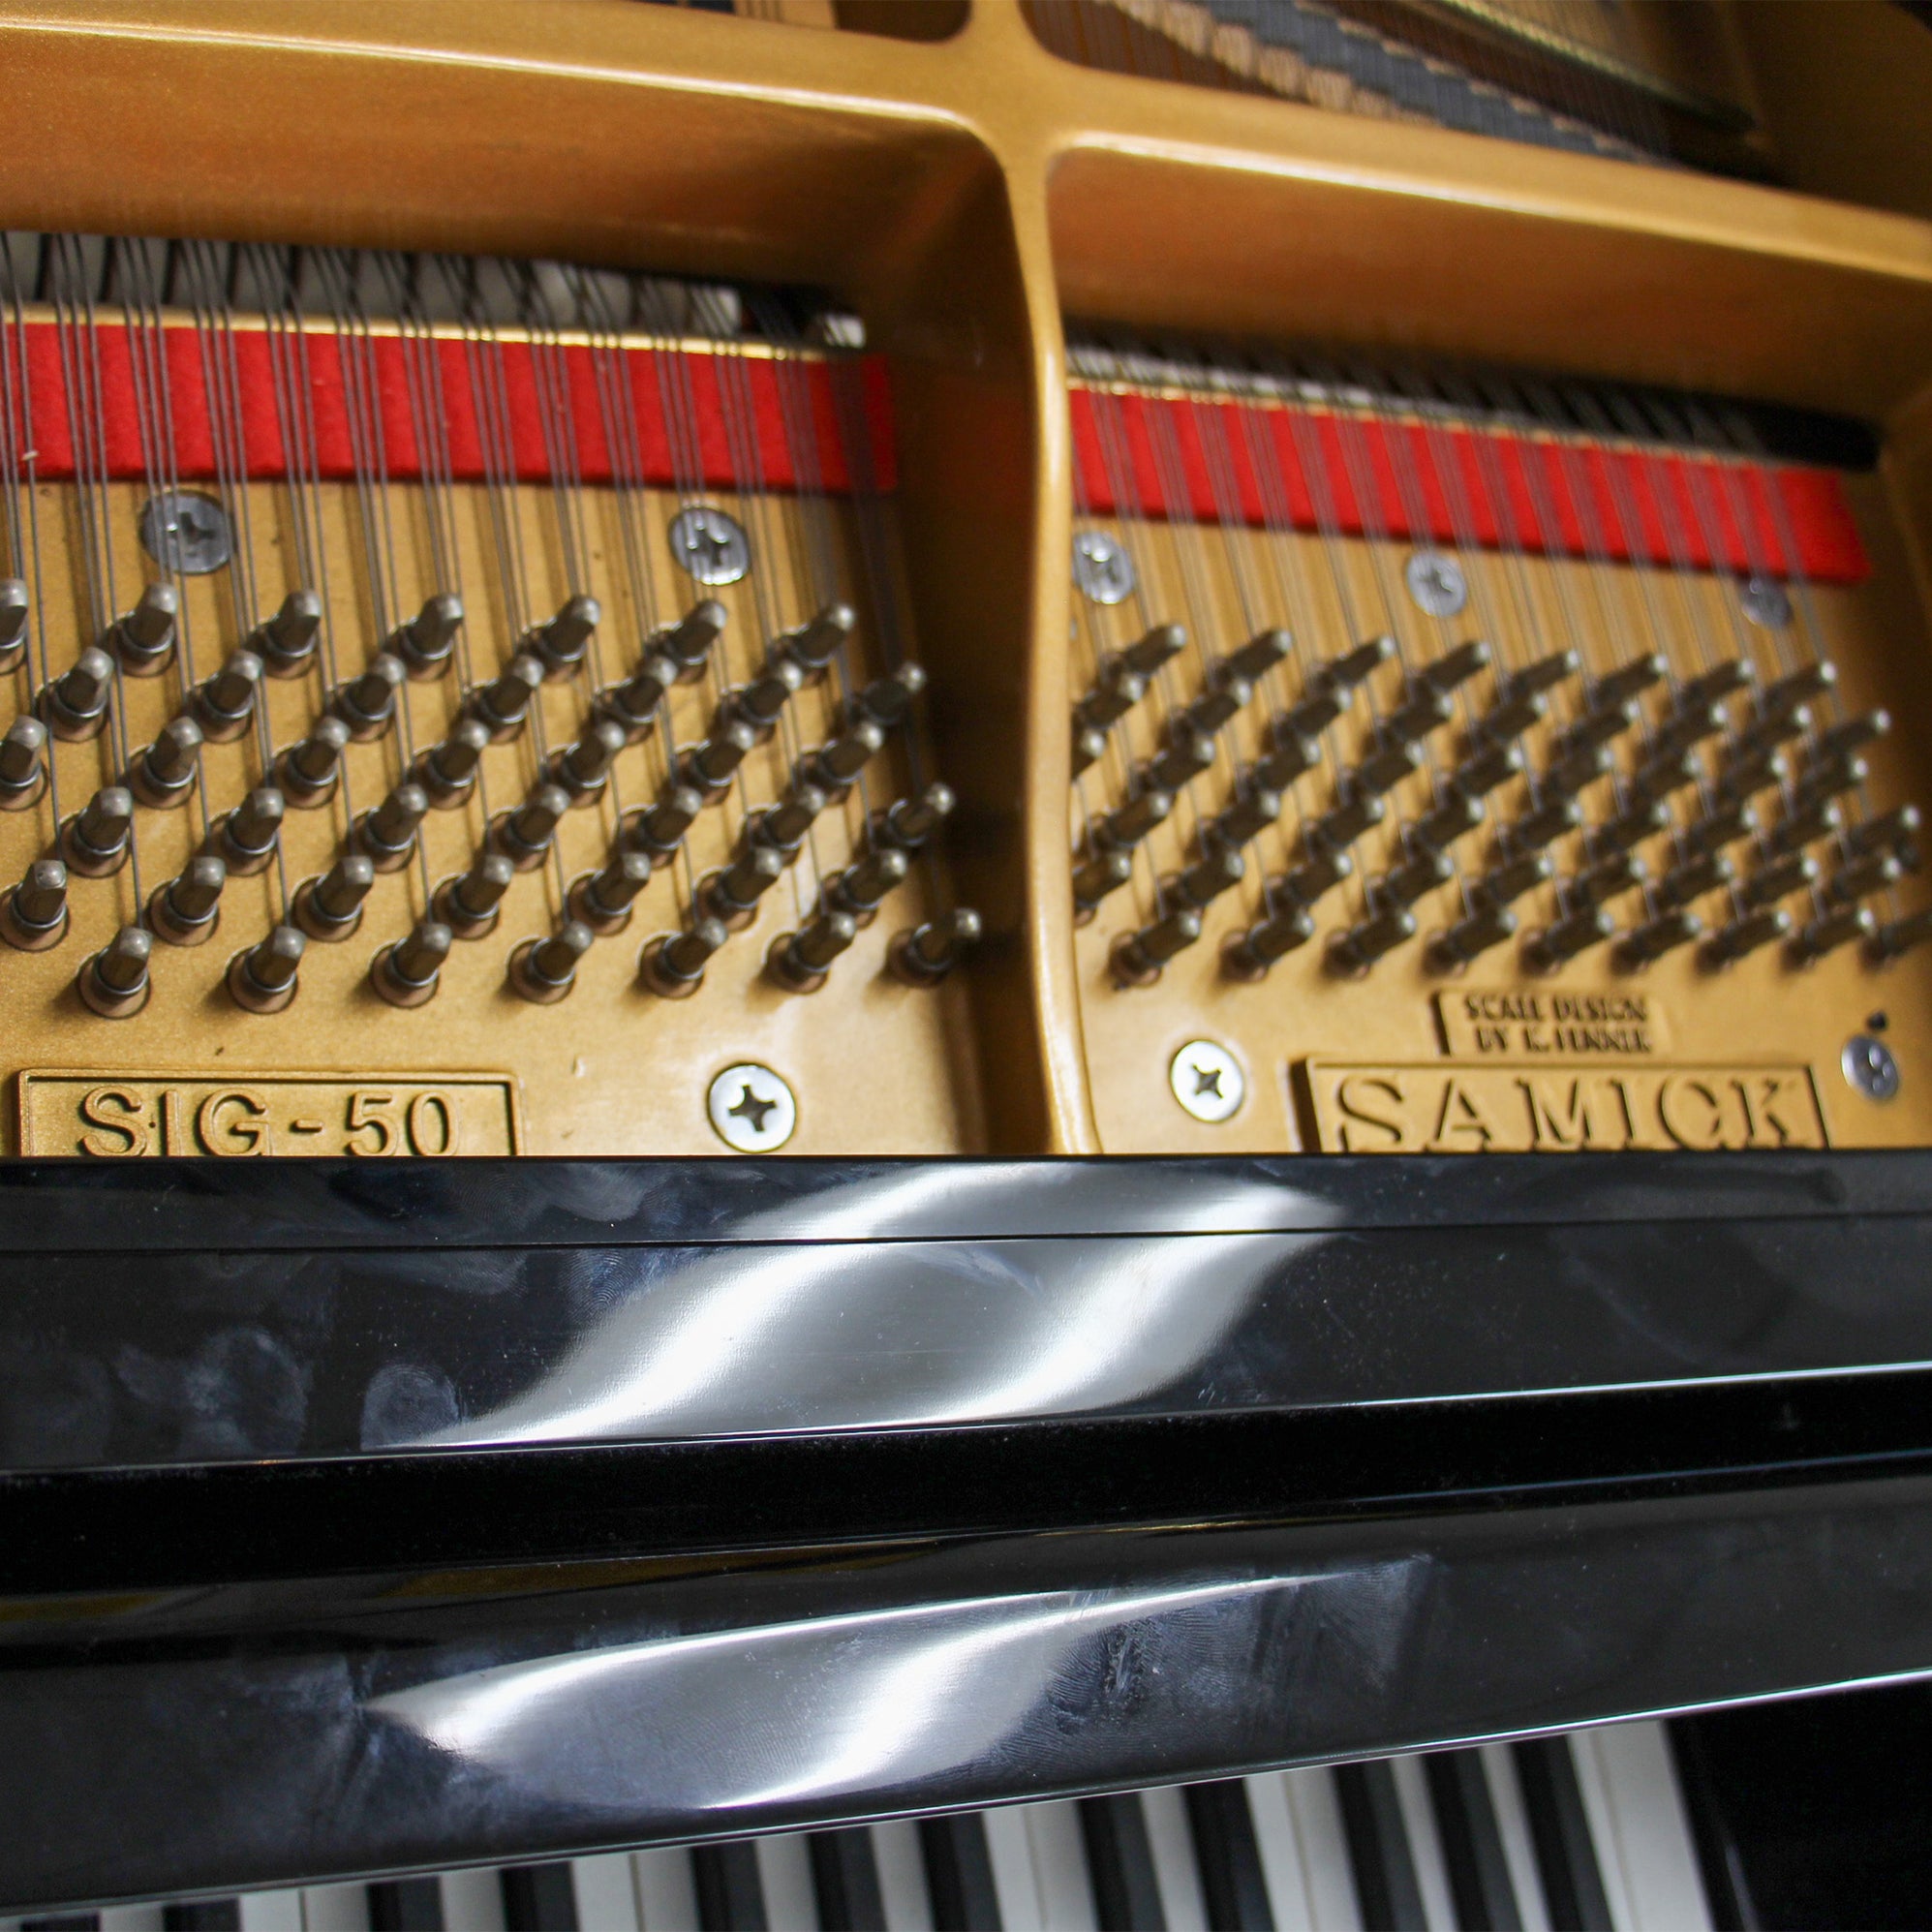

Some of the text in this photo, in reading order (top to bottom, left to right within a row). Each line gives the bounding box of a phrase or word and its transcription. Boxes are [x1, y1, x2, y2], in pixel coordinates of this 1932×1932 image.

[1552, 996, 1647, 1022] DESIGN
[1475, 1027, 1508, 1053] BY
[78, 1085, 458, 1156] SIG-50
[1335, 1075, 1794, 1151] SAMICK
